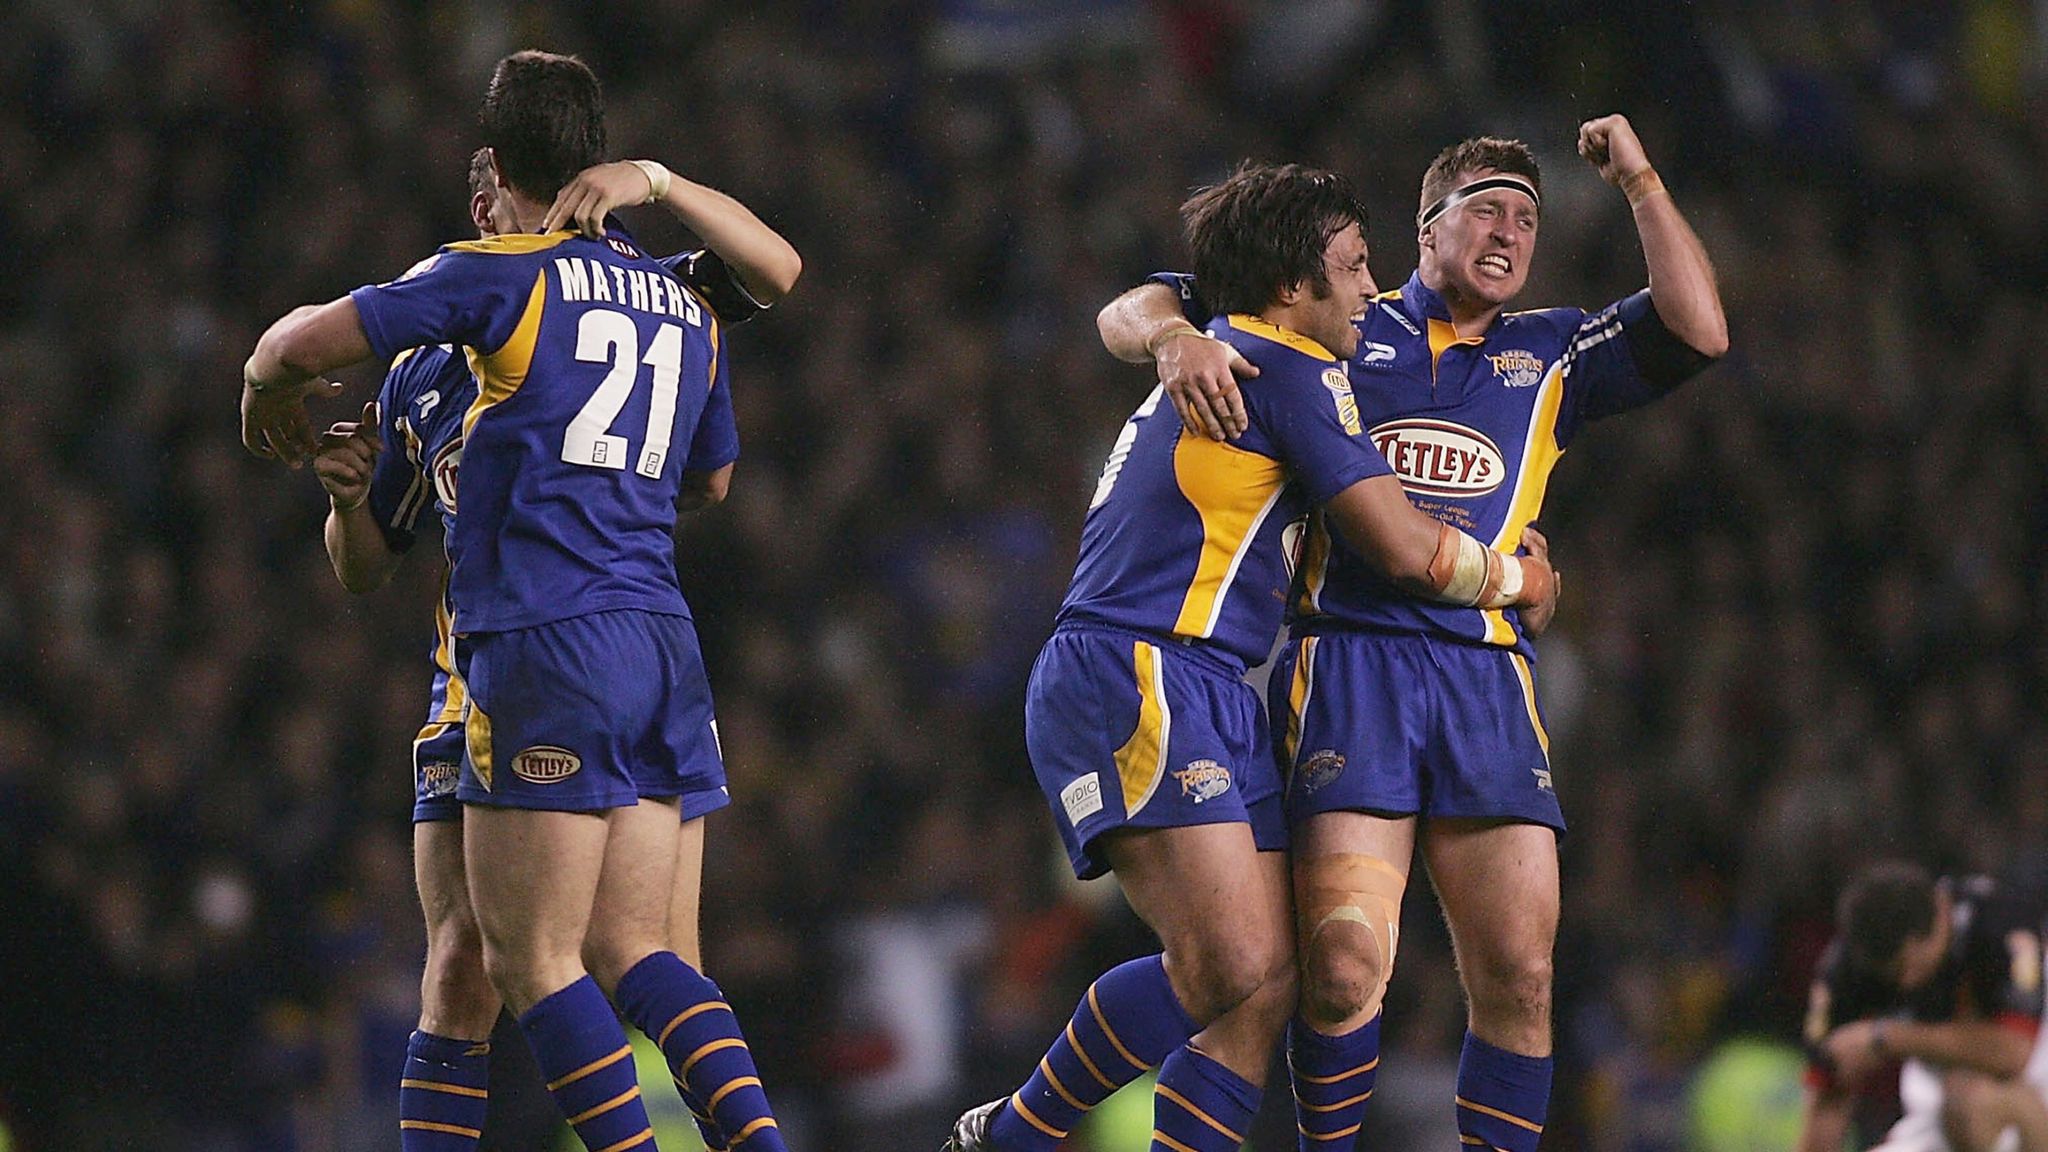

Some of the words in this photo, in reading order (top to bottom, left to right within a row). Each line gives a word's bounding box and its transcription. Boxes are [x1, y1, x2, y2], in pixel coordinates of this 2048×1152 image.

[608, 238, 640, 258] KIA
[554, 257, 702, 328] MATHERS
[561, 308, 684, 480] 21
